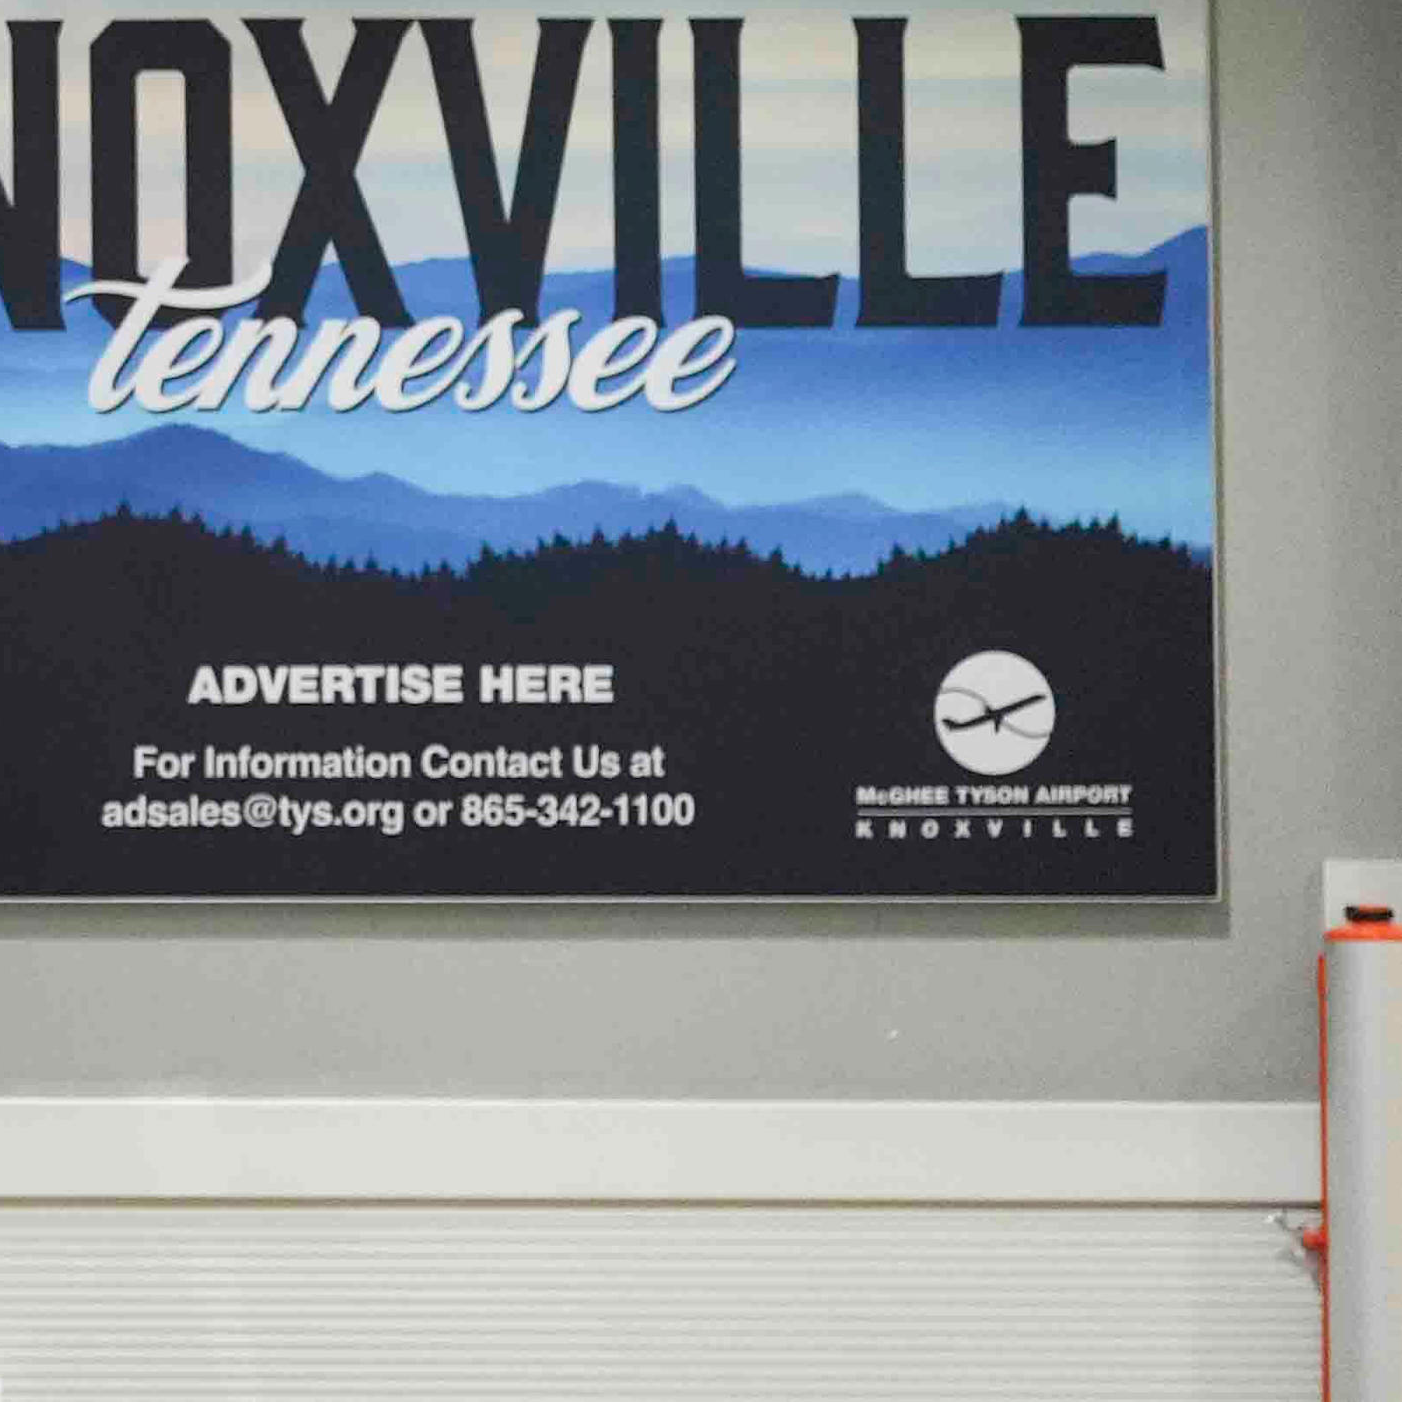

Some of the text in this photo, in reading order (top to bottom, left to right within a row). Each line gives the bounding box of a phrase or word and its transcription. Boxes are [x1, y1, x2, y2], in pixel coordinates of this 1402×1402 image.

[187, 664, 614, 704] ADVERTISE HERE
[134, 744, 665, 779] For Information Contact Us at
[855, 784, 1133, 806] McGHEE TYSON AIRPORT
[101, 792, 695, 835] adsales@tys.org or 865-342-1100
[855, 817, 1134, 839] KNOXVILLE
